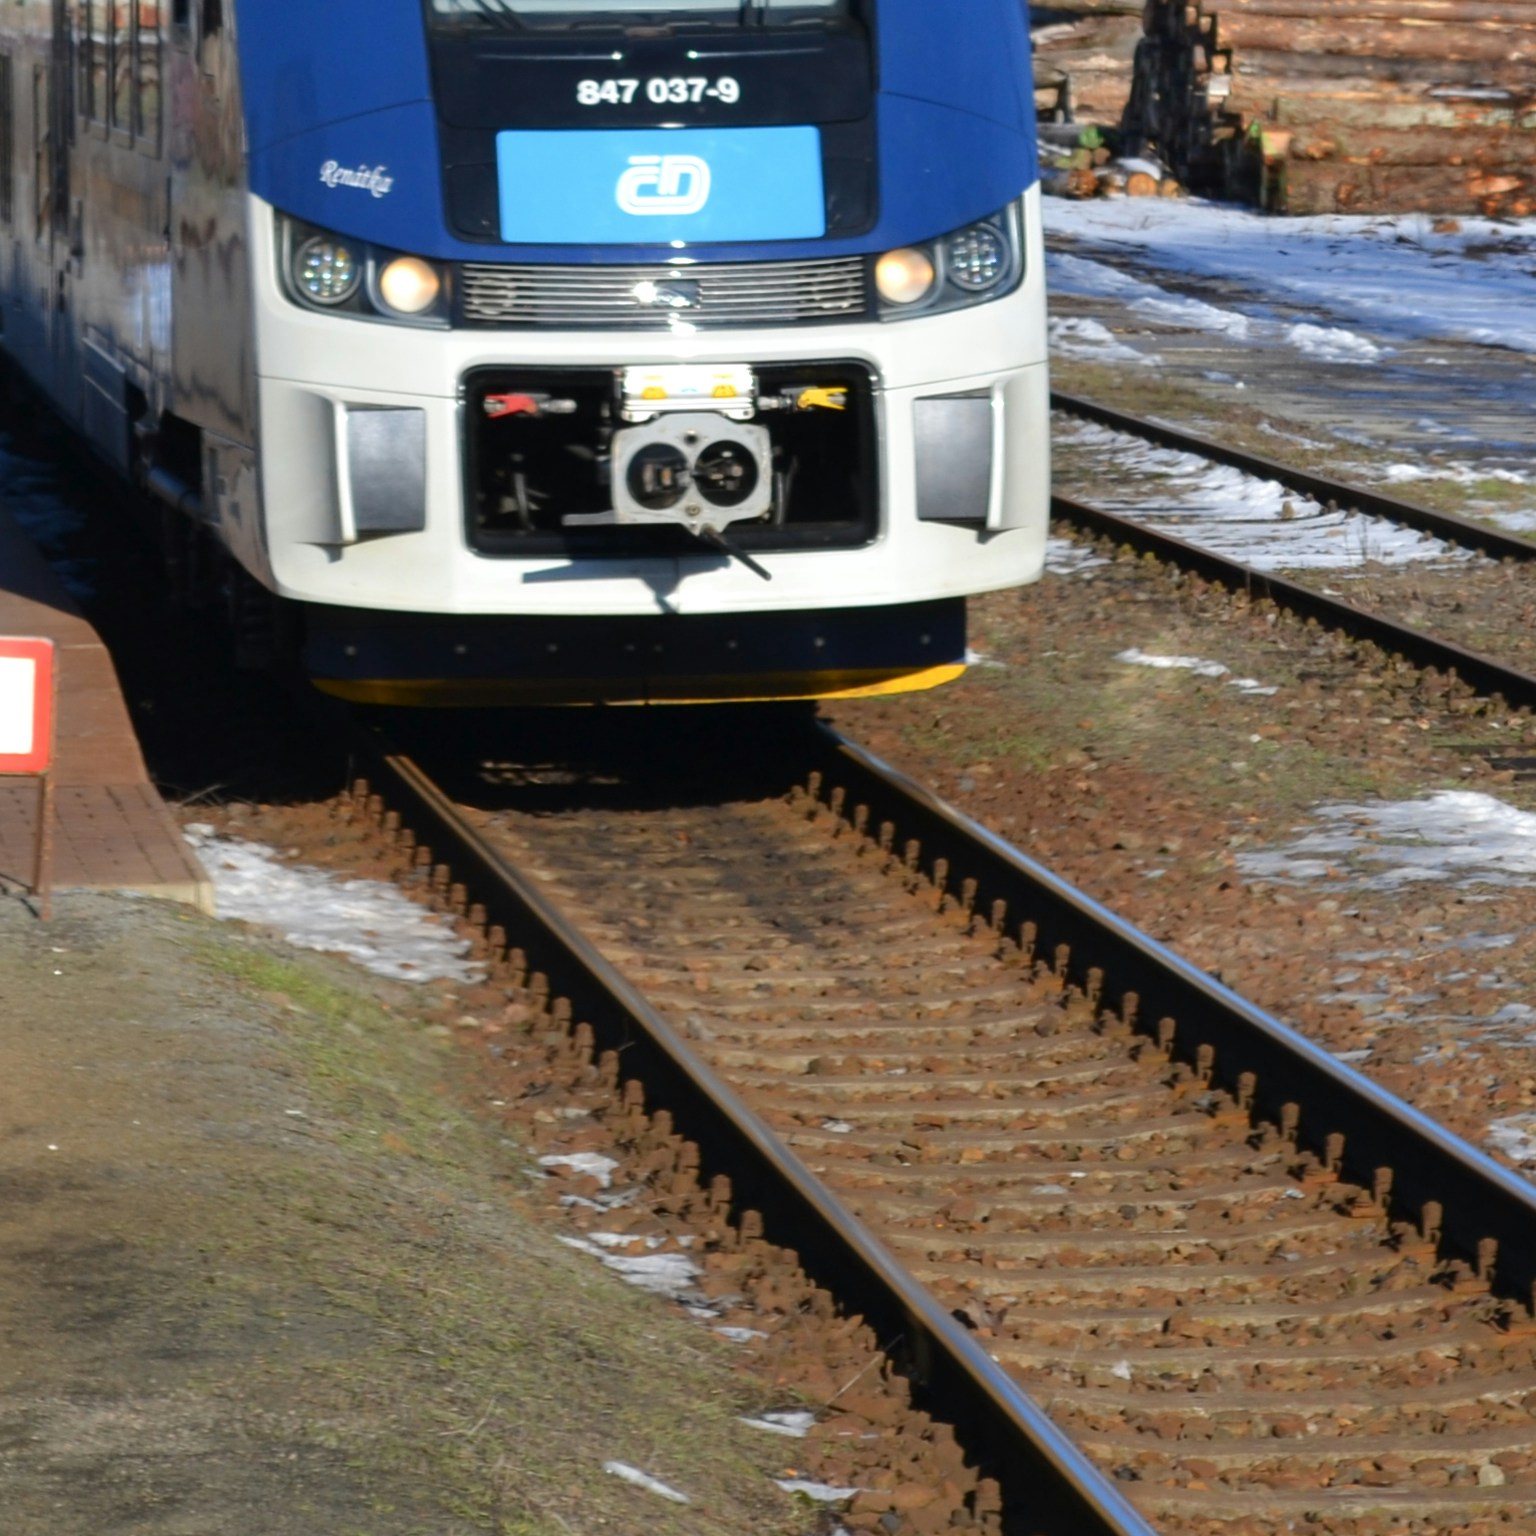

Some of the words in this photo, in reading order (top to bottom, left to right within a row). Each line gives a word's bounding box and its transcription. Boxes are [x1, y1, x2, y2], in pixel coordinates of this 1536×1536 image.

[577, 79, 639, 105] 847
[646, 77, 740, 104] 037-9
[320, 160, 393, 198] Renátka
